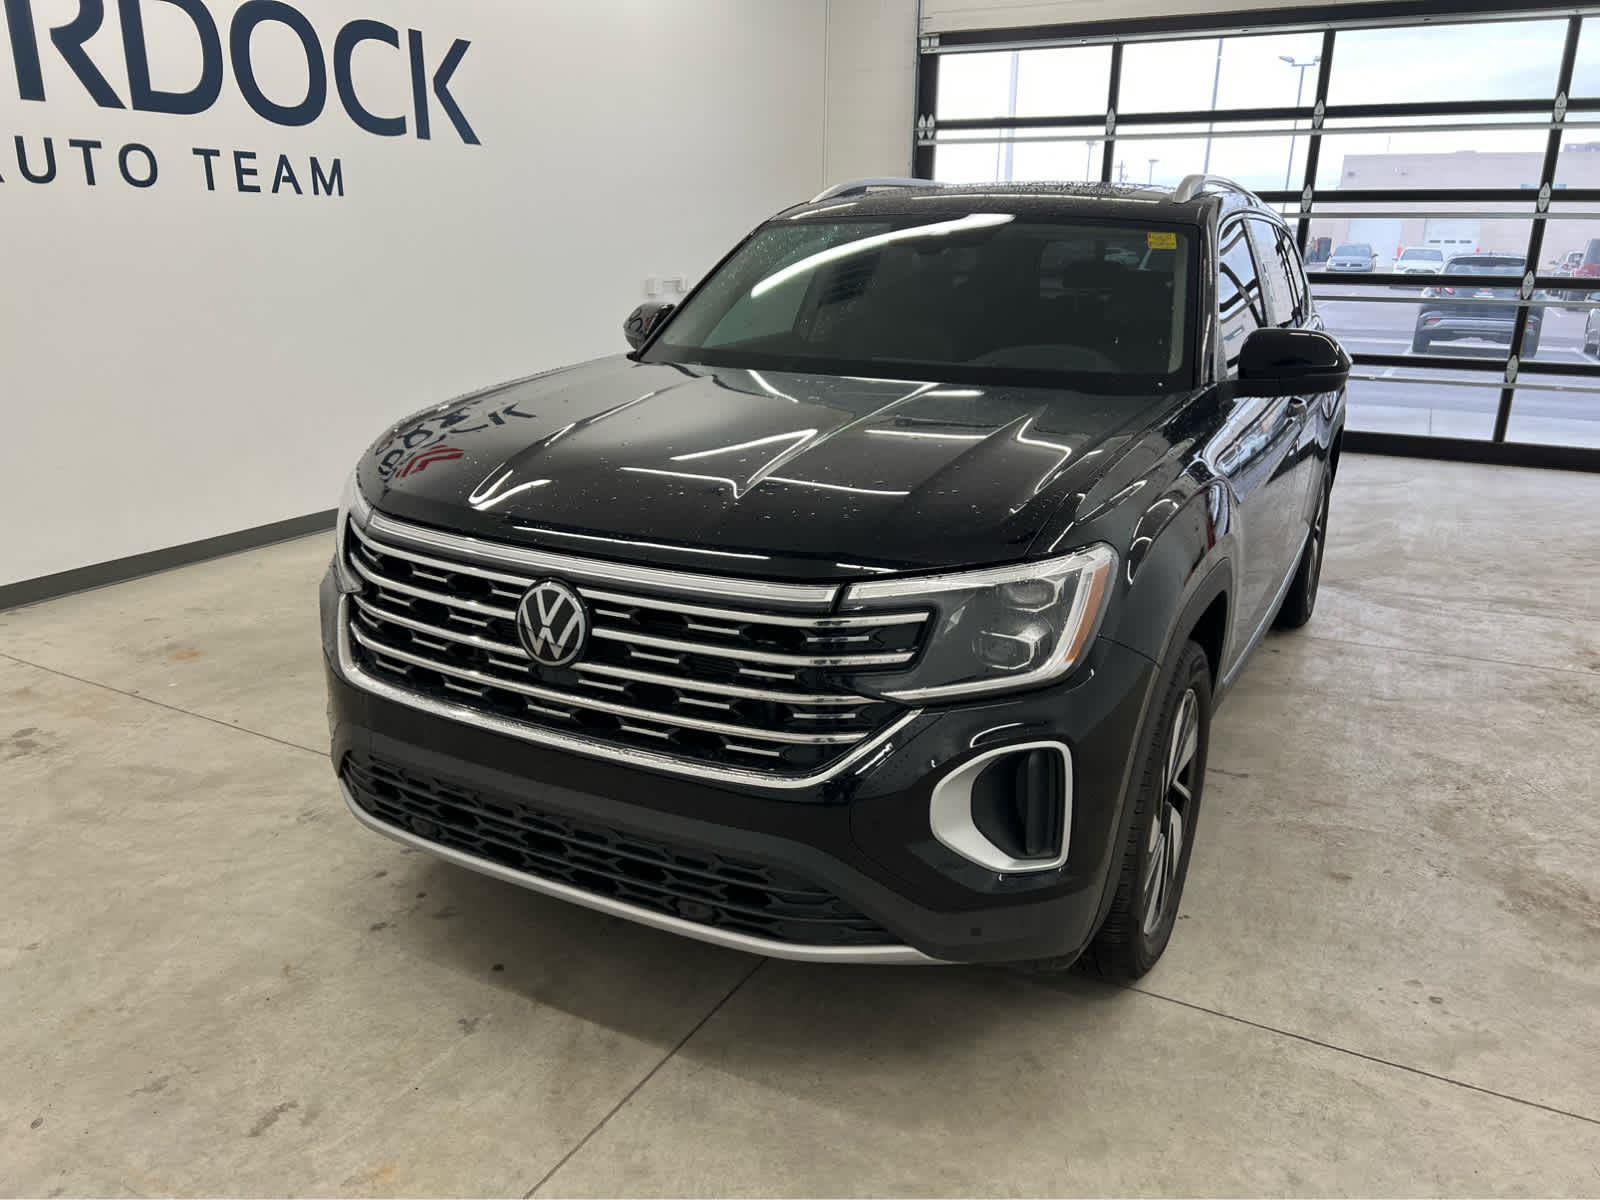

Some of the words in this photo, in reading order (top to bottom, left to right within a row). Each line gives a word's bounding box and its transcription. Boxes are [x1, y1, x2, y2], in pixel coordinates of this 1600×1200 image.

[3, 0, 482, 146] RDOCK
[0, 135, 159, 189] UTO
[191, 147, 345, 197] TEAM
